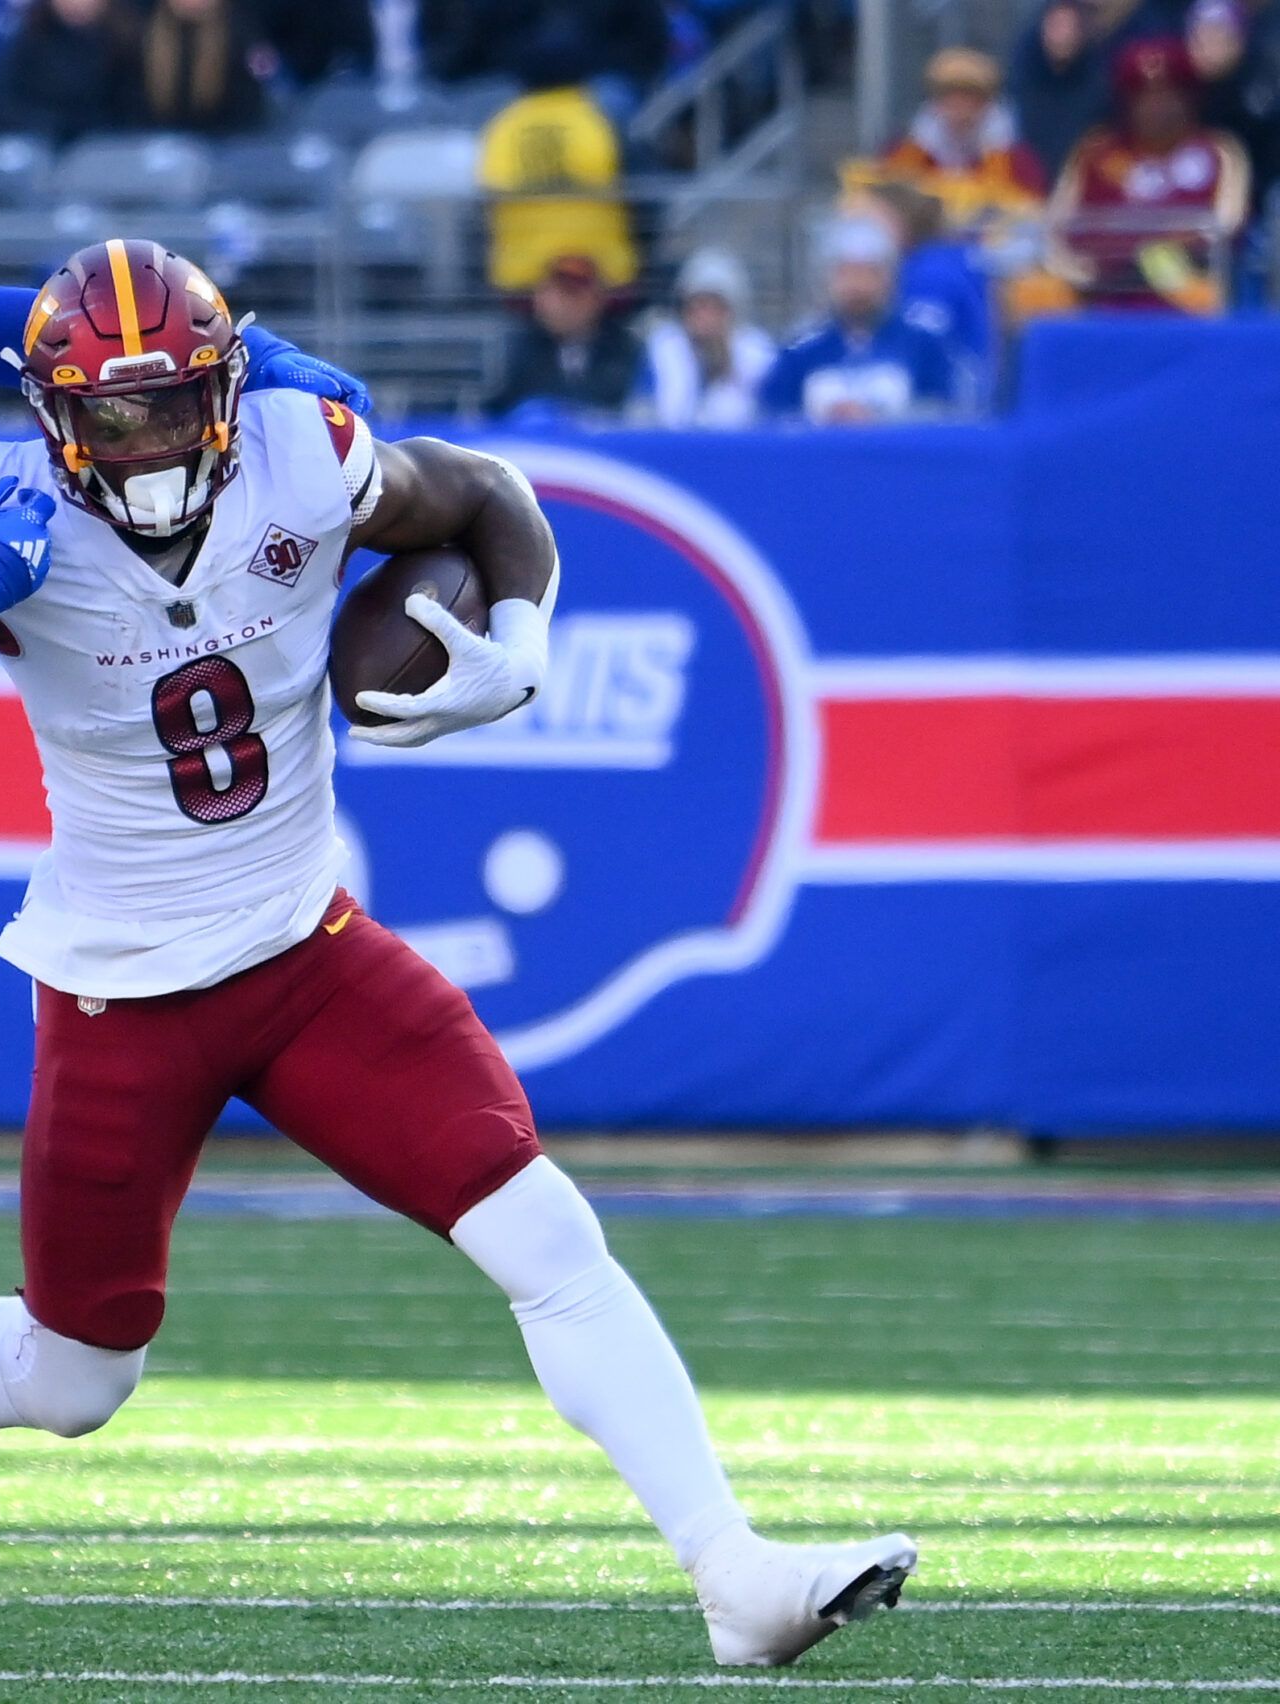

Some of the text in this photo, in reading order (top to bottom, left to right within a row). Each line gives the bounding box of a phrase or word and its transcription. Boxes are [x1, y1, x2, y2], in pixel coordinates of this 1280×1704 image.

[264, 538, 302, 576] 90
[96, 616, 274, 666] WASHINGTON
[151, 655, 269, 825] 8
